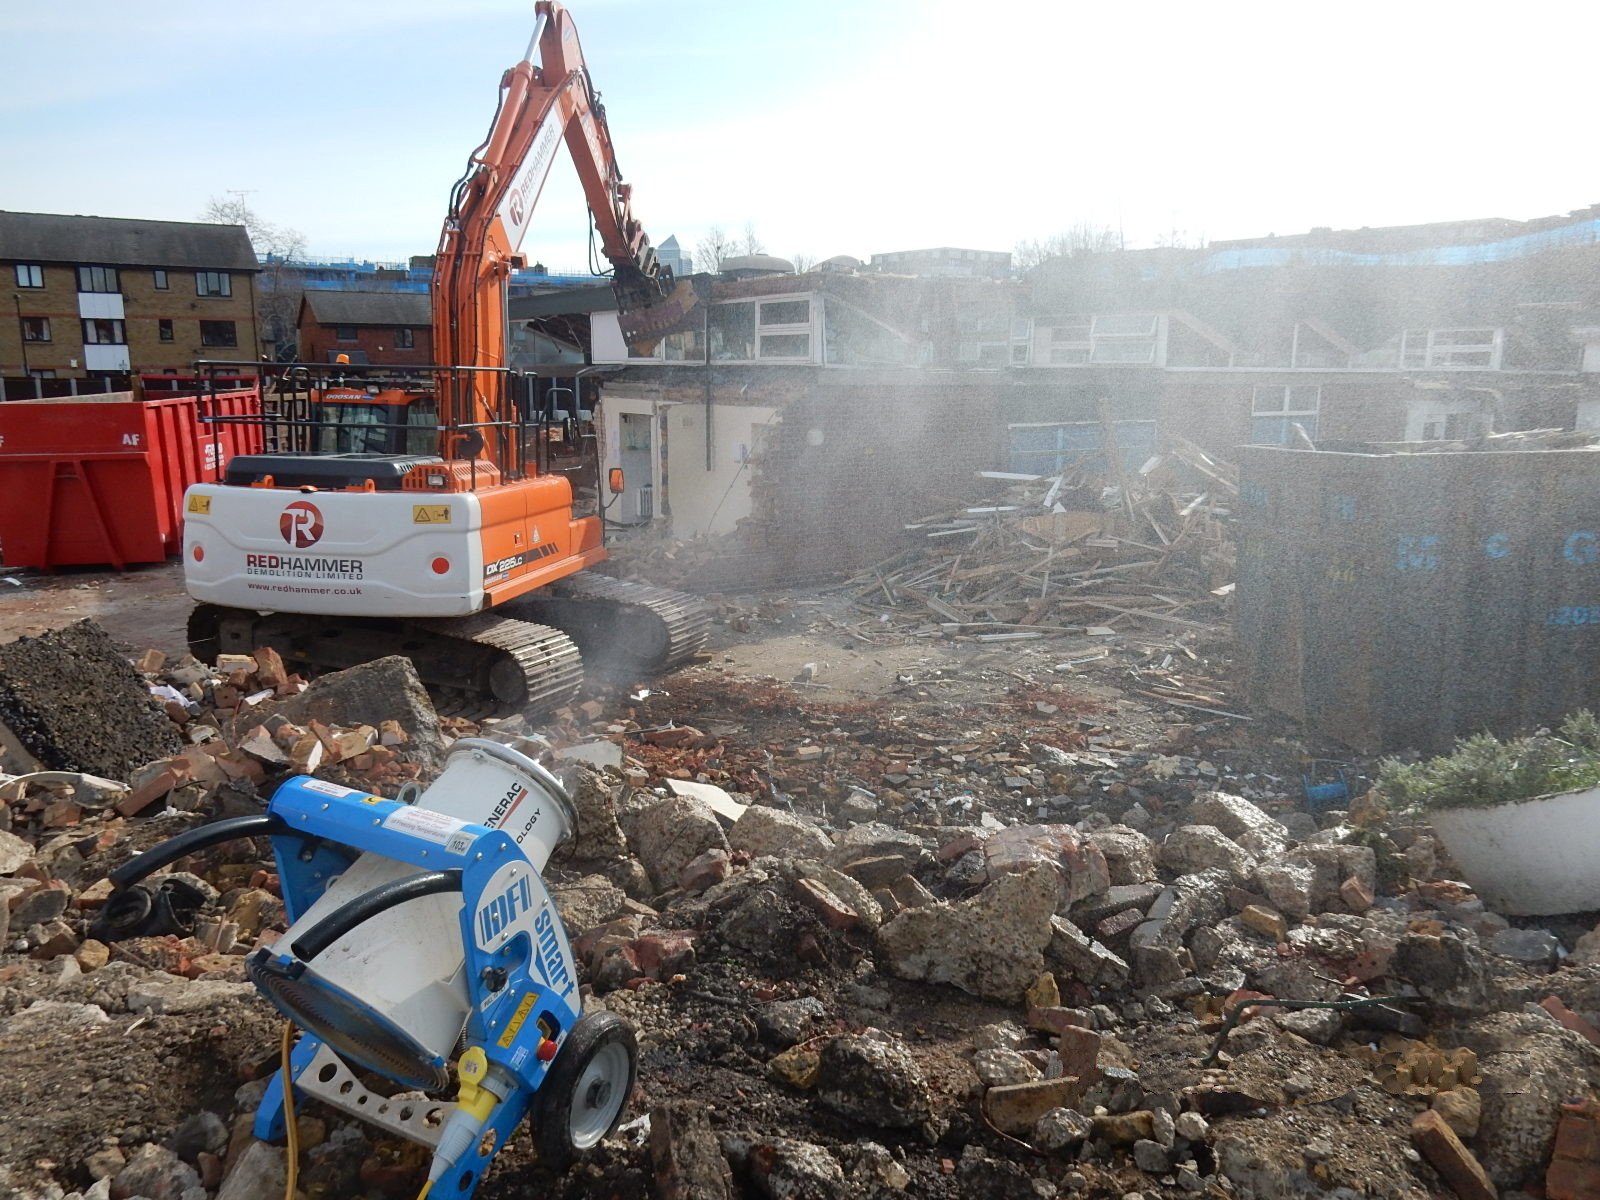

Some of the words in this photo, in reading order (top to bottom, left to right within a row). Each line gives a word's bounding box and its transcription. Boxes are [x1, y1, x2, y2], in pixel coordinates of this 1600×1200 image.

[122, 433, 140, 446] AF
[246, 554, 363, 573] REDHAMMER
[247, 568, 312, 579] DEMOLITION
[316, 572, 364, 581] LIMITED
[248, 583, 363, 596] www.redhammer.co.uk
[483, 782, 523, 829] ENERAC
[534, 909, 575, 998] smart
